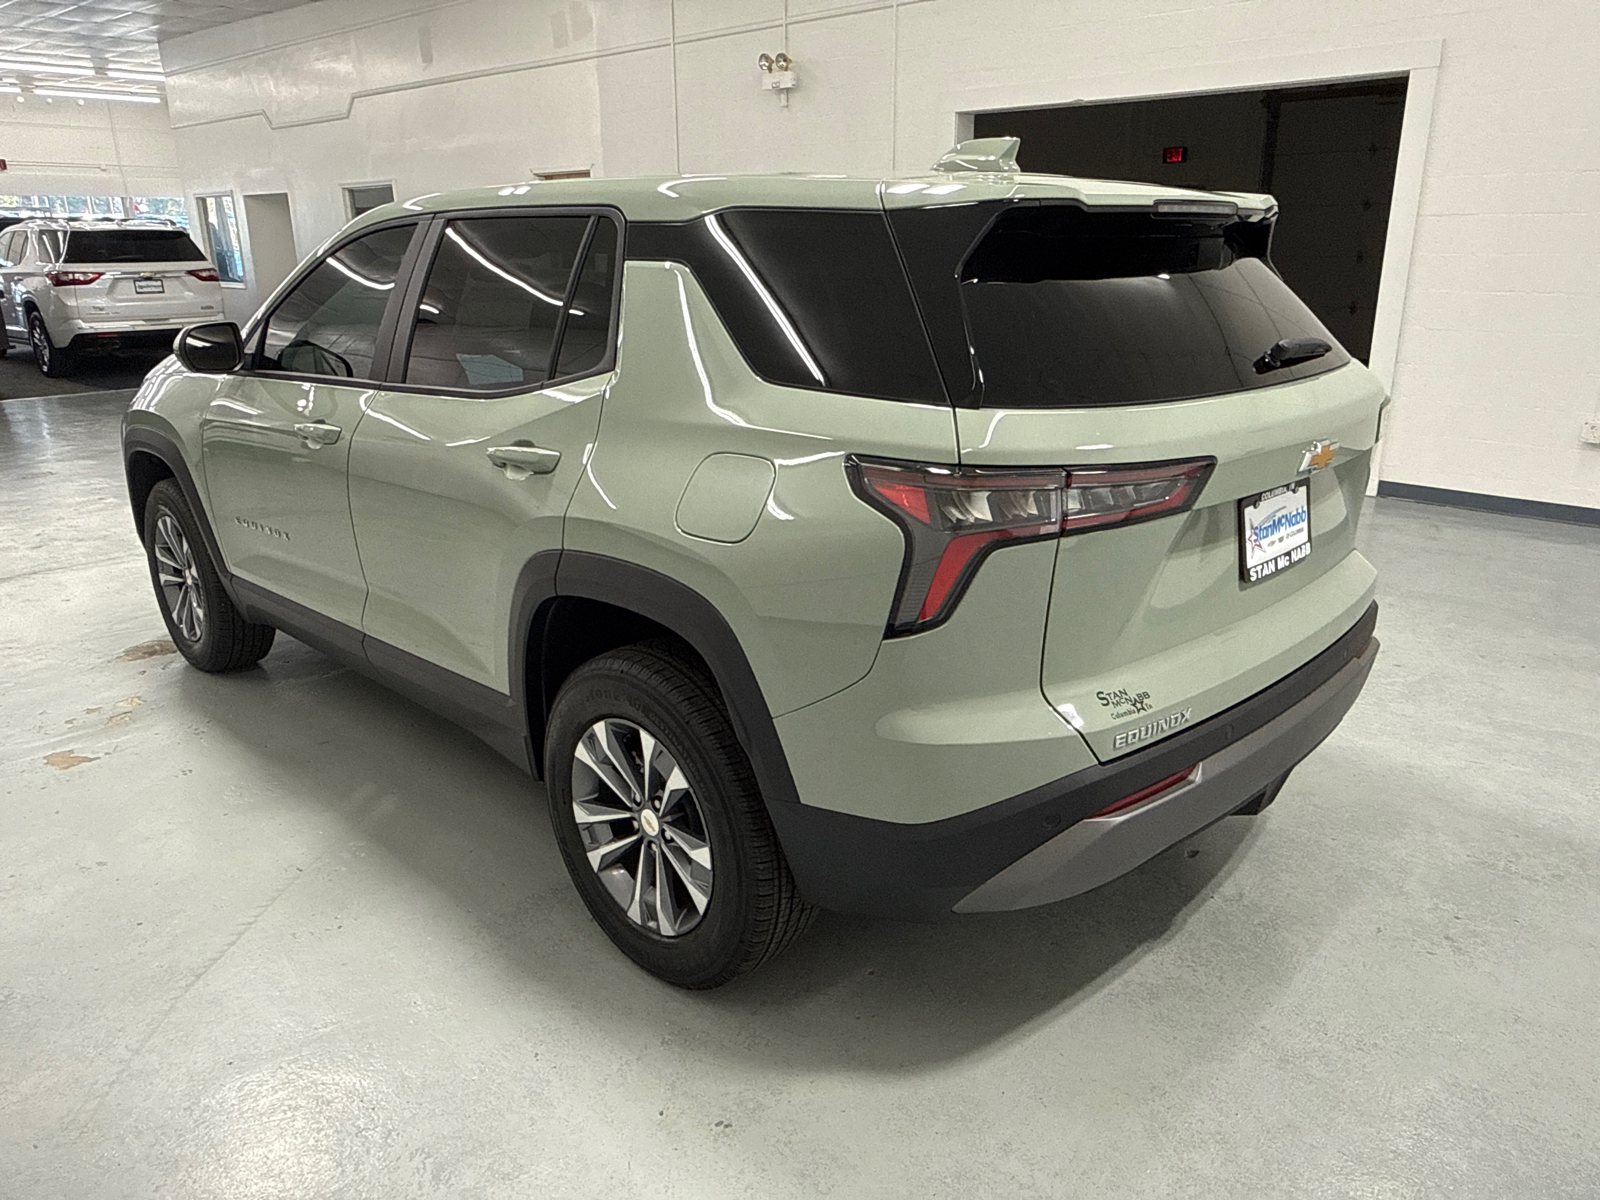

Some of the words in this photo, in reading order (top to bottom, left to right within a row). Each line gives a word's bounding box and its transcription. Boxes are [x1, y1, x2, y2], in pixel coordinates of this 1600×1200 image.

[1249, 560, 1276, 582] STAN
[1277, 555, 1290, 570] Mc
[1291, 542, 1311, 563] NABB
[1114, 707, 1192, 749] EQUINOX
